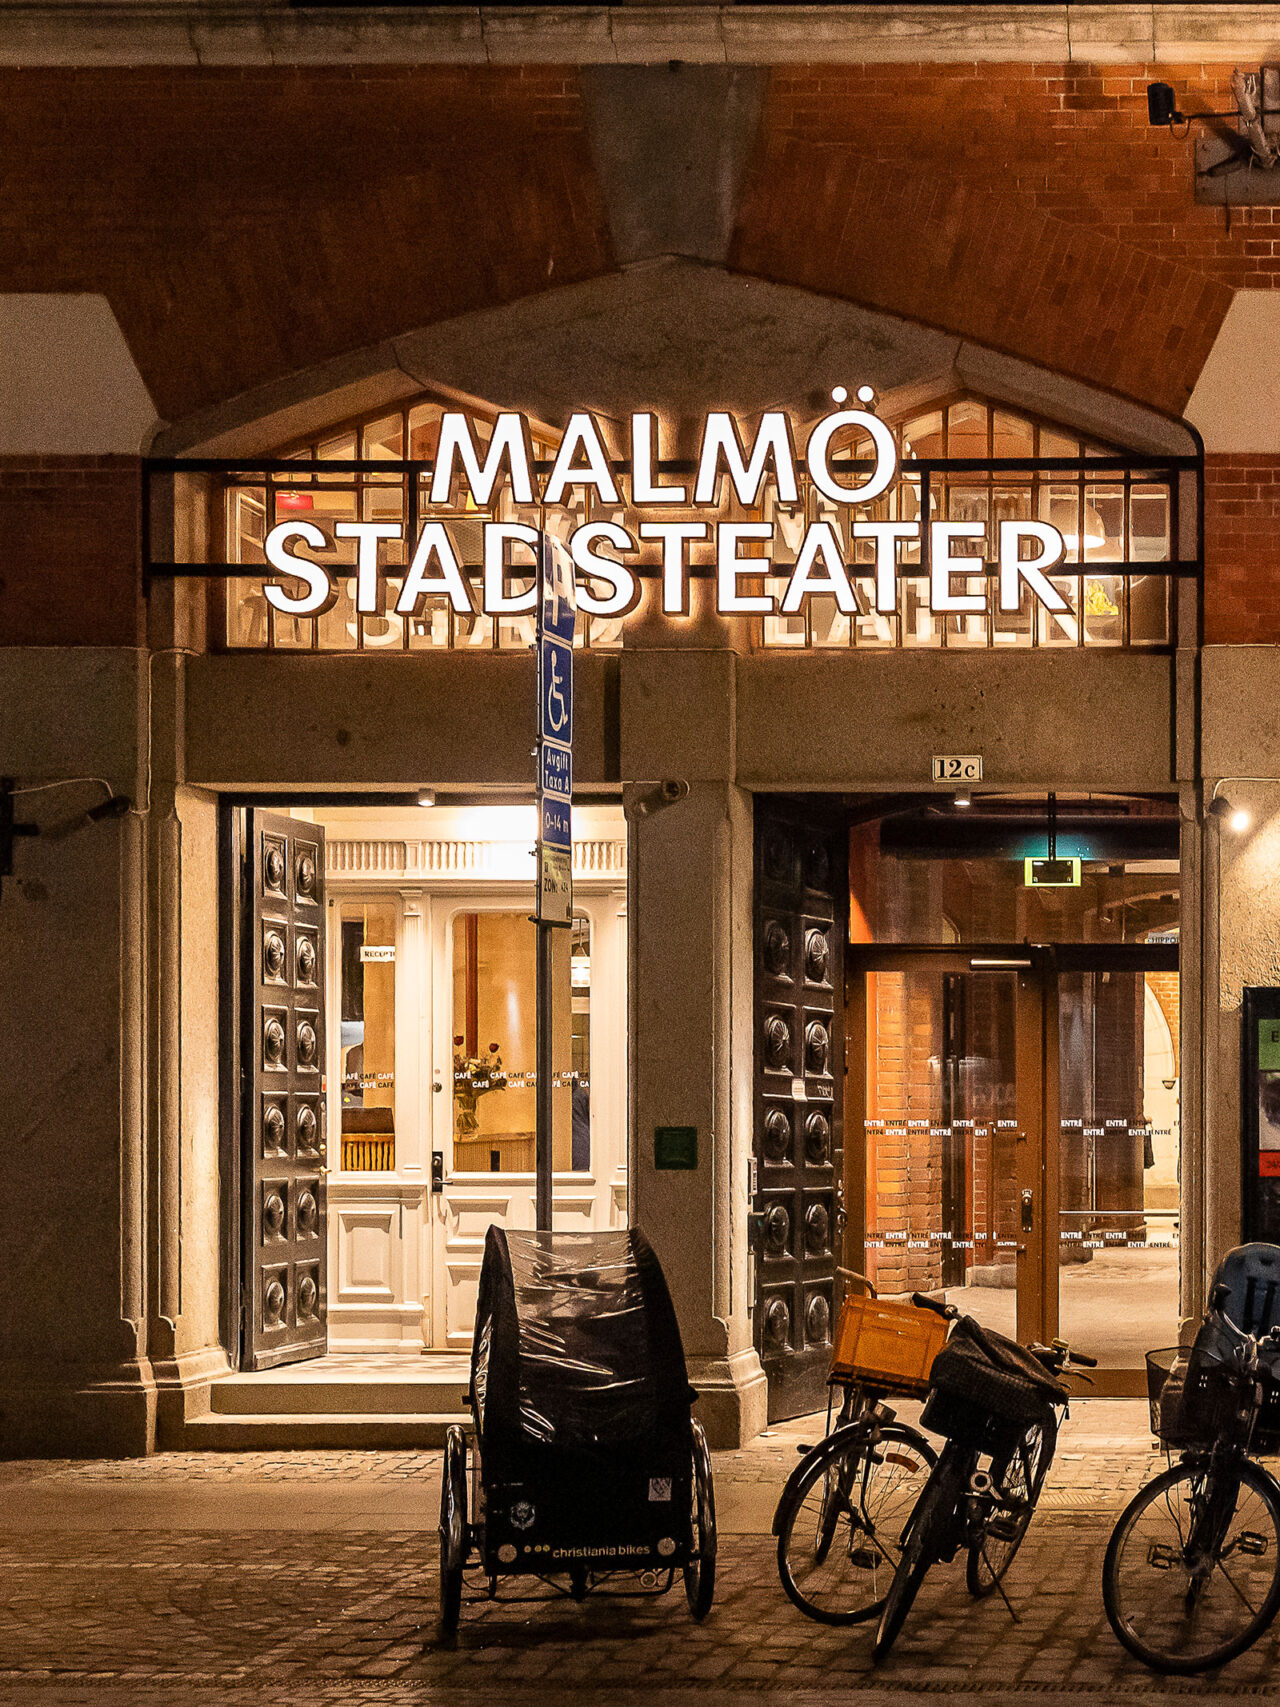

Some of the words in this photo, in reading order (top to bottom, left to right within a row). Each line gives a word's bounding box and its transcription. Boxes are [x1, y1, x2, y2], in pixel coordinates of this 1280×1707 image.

[431, 386, 897, 504] MALMÖ
[264, 520, 1076, 616] STADSTEATER
[546, 748, 568, 772] Avgift
[545, 770, 562, 791] Taxa
[564, 776, 569, 793] A
[563, 820, 569, 833] m
[454, 1071, 471, 1079] CAFÉ
[562, 1070, 579, 1079] CAFÉ
[472, 1080, 489, 1088] CAFÉ
[580, 1080, 590, 1088] CA
[864, 1119, 885, 1127] ENTRÉ
[907, 1119, 929, 1128] ENTRÉ
[952, 1119, 974, 1128] ENTRÉ
[1060, 1119, 1082, 1127] ENTRÉ
[1105, 1119, 1127, 1127] ENTRÉ
[885, 1128, 907, 1136] ENTRÉ
[930, 1128, 952, 1136] ENTRÉ
[1083, 1128, 1105, 1136] ENTRÉ
[885, 1231, 907, 1239] ENTRÉ
[930, 1231, 952, 1239] ENTRÉ
[1060, 1231, 1082, 1239] ENTRÉ
[1105, 1231, 1127, 1239] ENTRÉ
[864, 1240, 885, 1248] ENTRÉ
[907, 1240, 929, 1248] ENTRÉ
[952, 1240, 974, 1248] ENTRÉ
[1083, 1240, 1104, 1248] ENTRÉ
[552, 1546, 617, 1559] christiania
[618, 1544, 651, 1555] bikes
